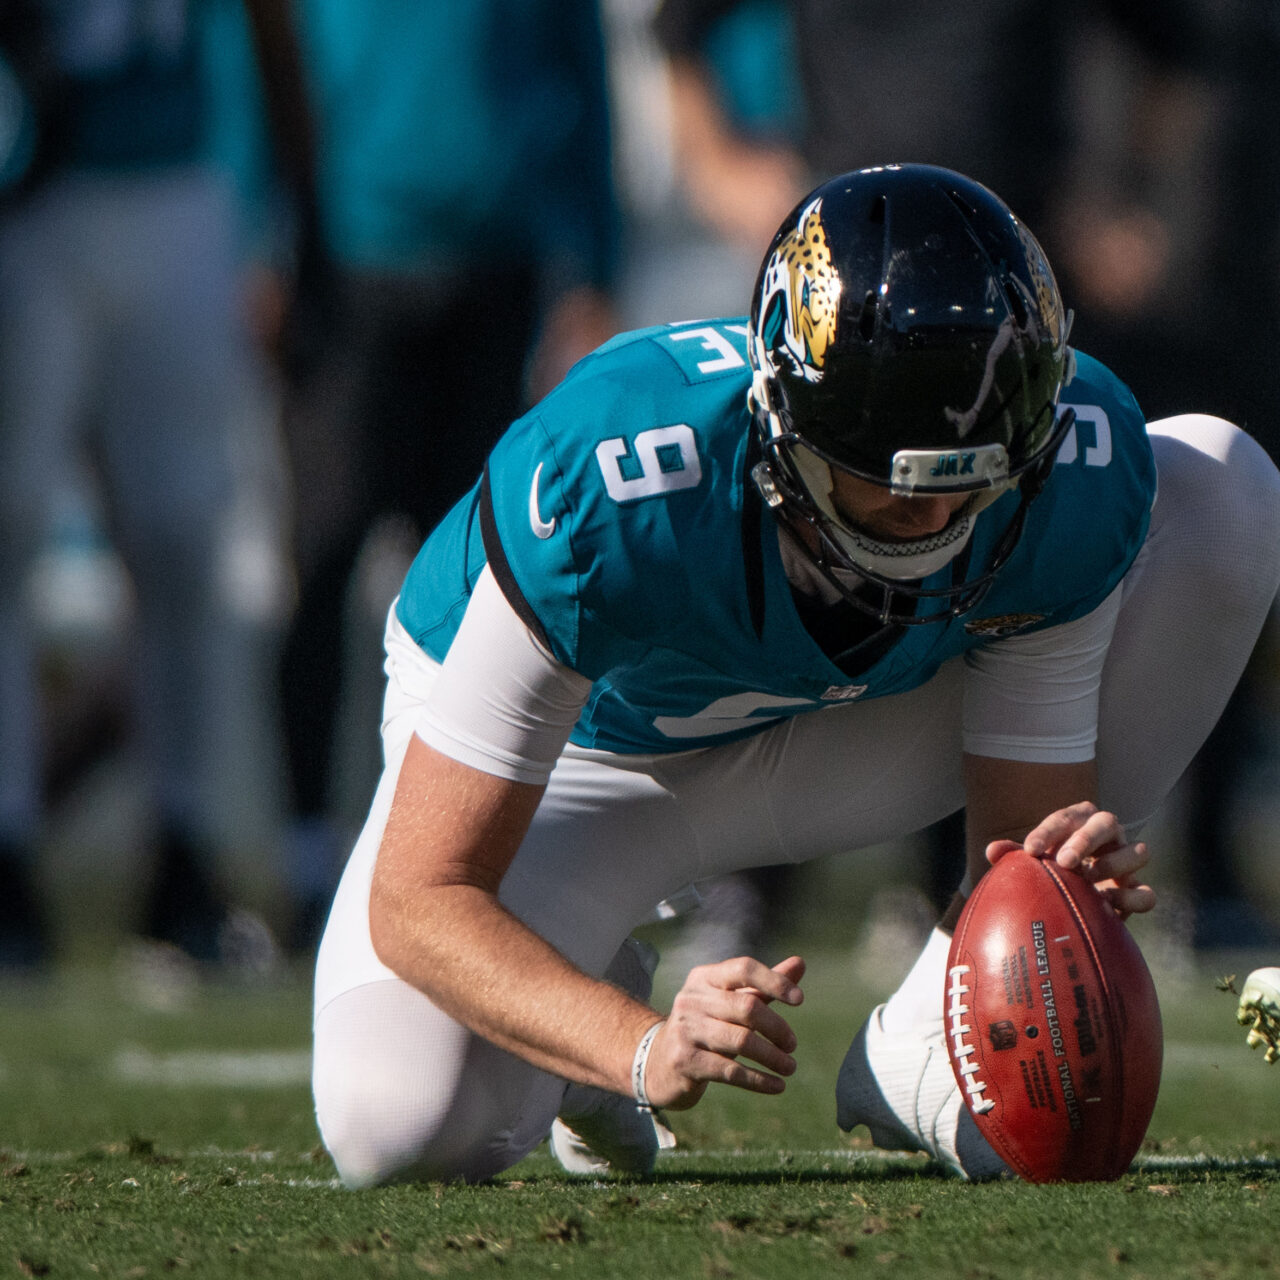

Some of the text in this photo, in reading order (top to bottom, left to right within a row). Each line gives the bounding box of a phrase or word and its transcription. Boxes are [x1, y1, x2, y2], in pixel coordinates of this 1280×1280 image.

[595, 424, 701, 502] 9
[930, 452, 976, 476] JAX
[1033, 921, 1082, 1130] NATIONAL FOOTBALL LEAGUE
